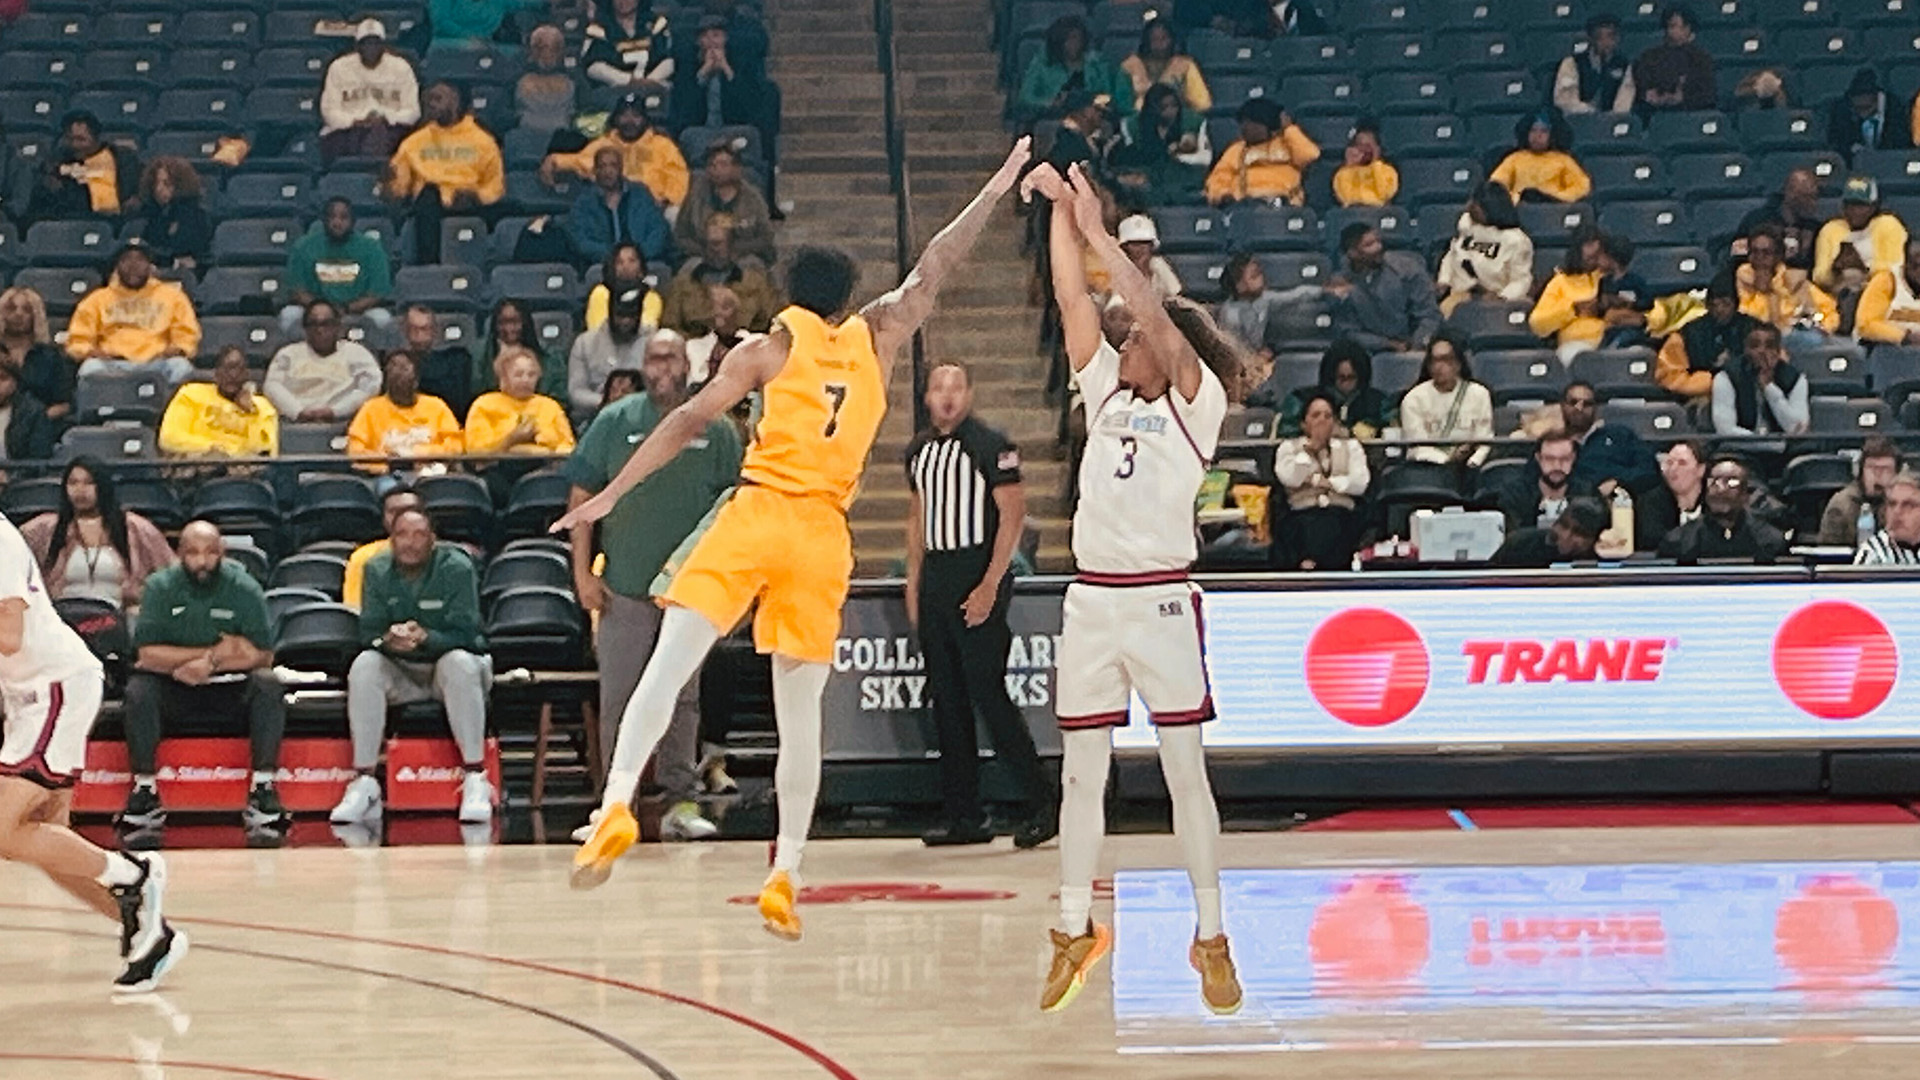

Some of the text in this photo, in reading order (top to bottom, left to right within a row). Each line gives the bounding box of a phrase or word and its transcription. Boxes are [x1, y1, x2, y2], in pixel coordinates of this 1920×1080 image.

[622, 50, 650, 79] 7
[825, 384, 847, 438] 7
[1113, 436, 1138, 480] 3
[834, 634, 1062, 671] COLL AR
[1462, 638, 1667, 684] TRANE
[860, 674, 1050, 709] SKYKS
